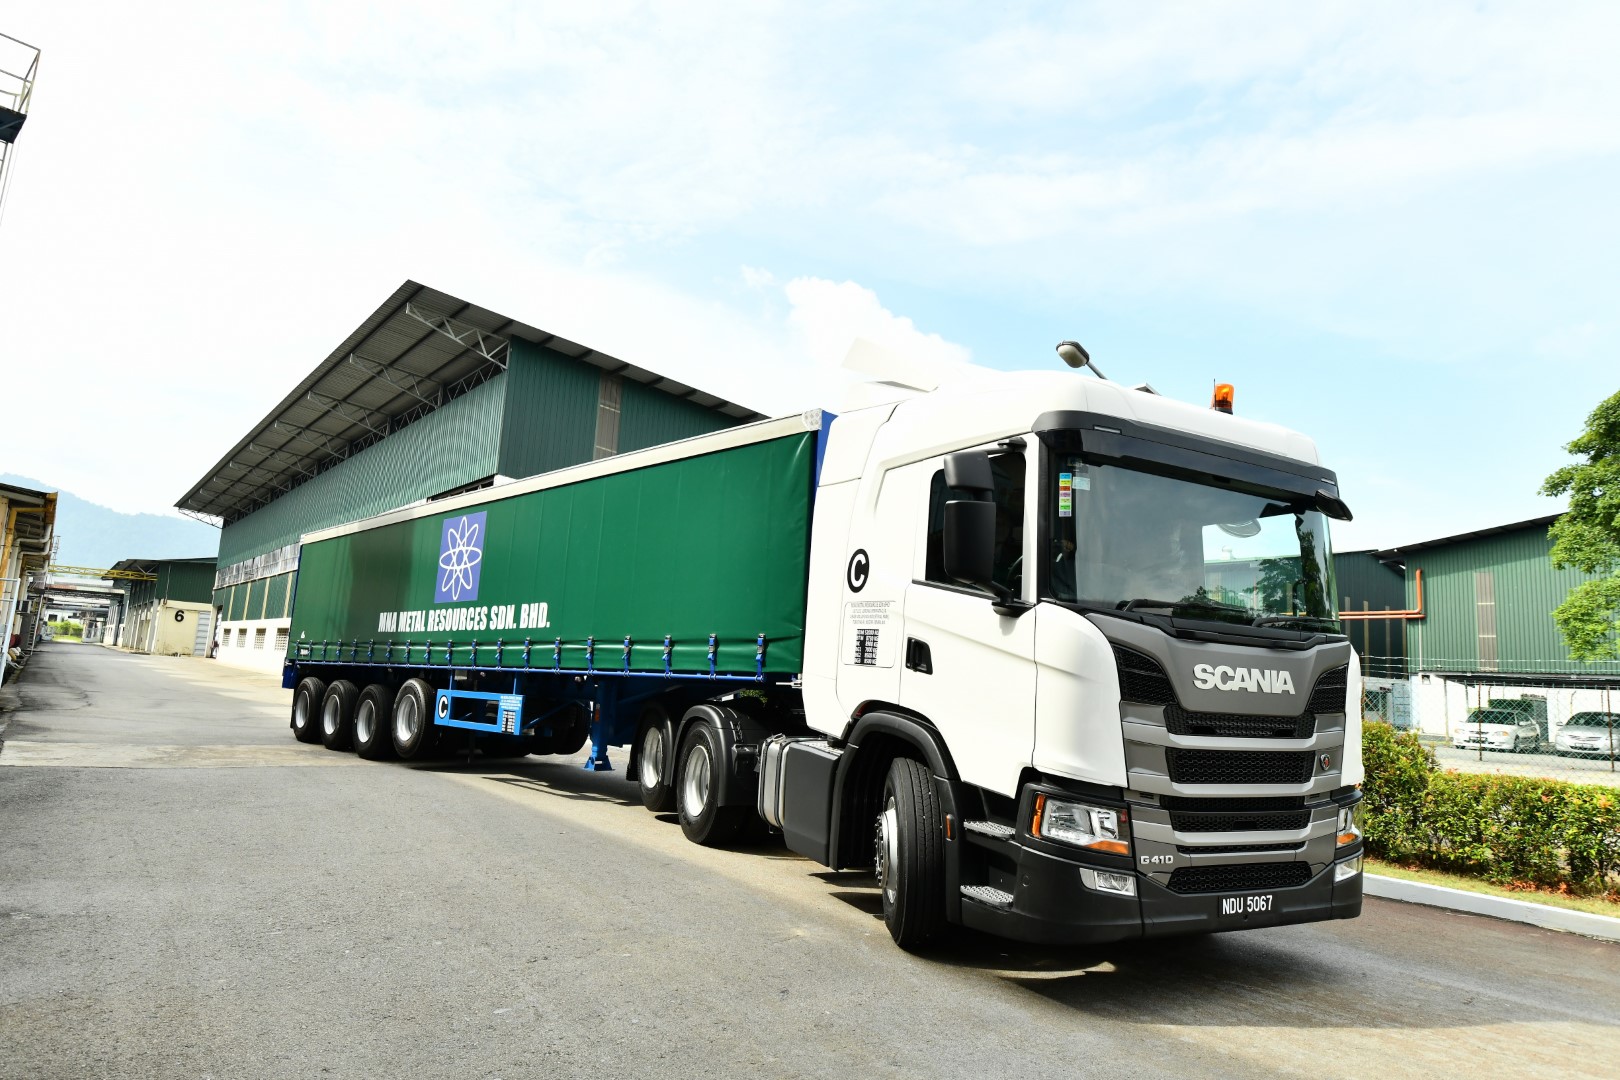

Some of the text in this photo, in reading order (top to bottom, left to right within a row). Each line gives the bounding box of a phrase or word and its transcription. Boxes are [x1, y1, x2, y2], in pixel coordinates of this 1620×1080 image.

[850, 553, 867, 588] C
[174, 609, 185, 623] 6
[378, 602, 551, 632] MNA METAL RESOURCES SDN. BHD.
[1193, 663, 1296, 695] SCANIA
[438, 696, 448, 719] C
[1222, 894, 1273, 915] NDU 5067
